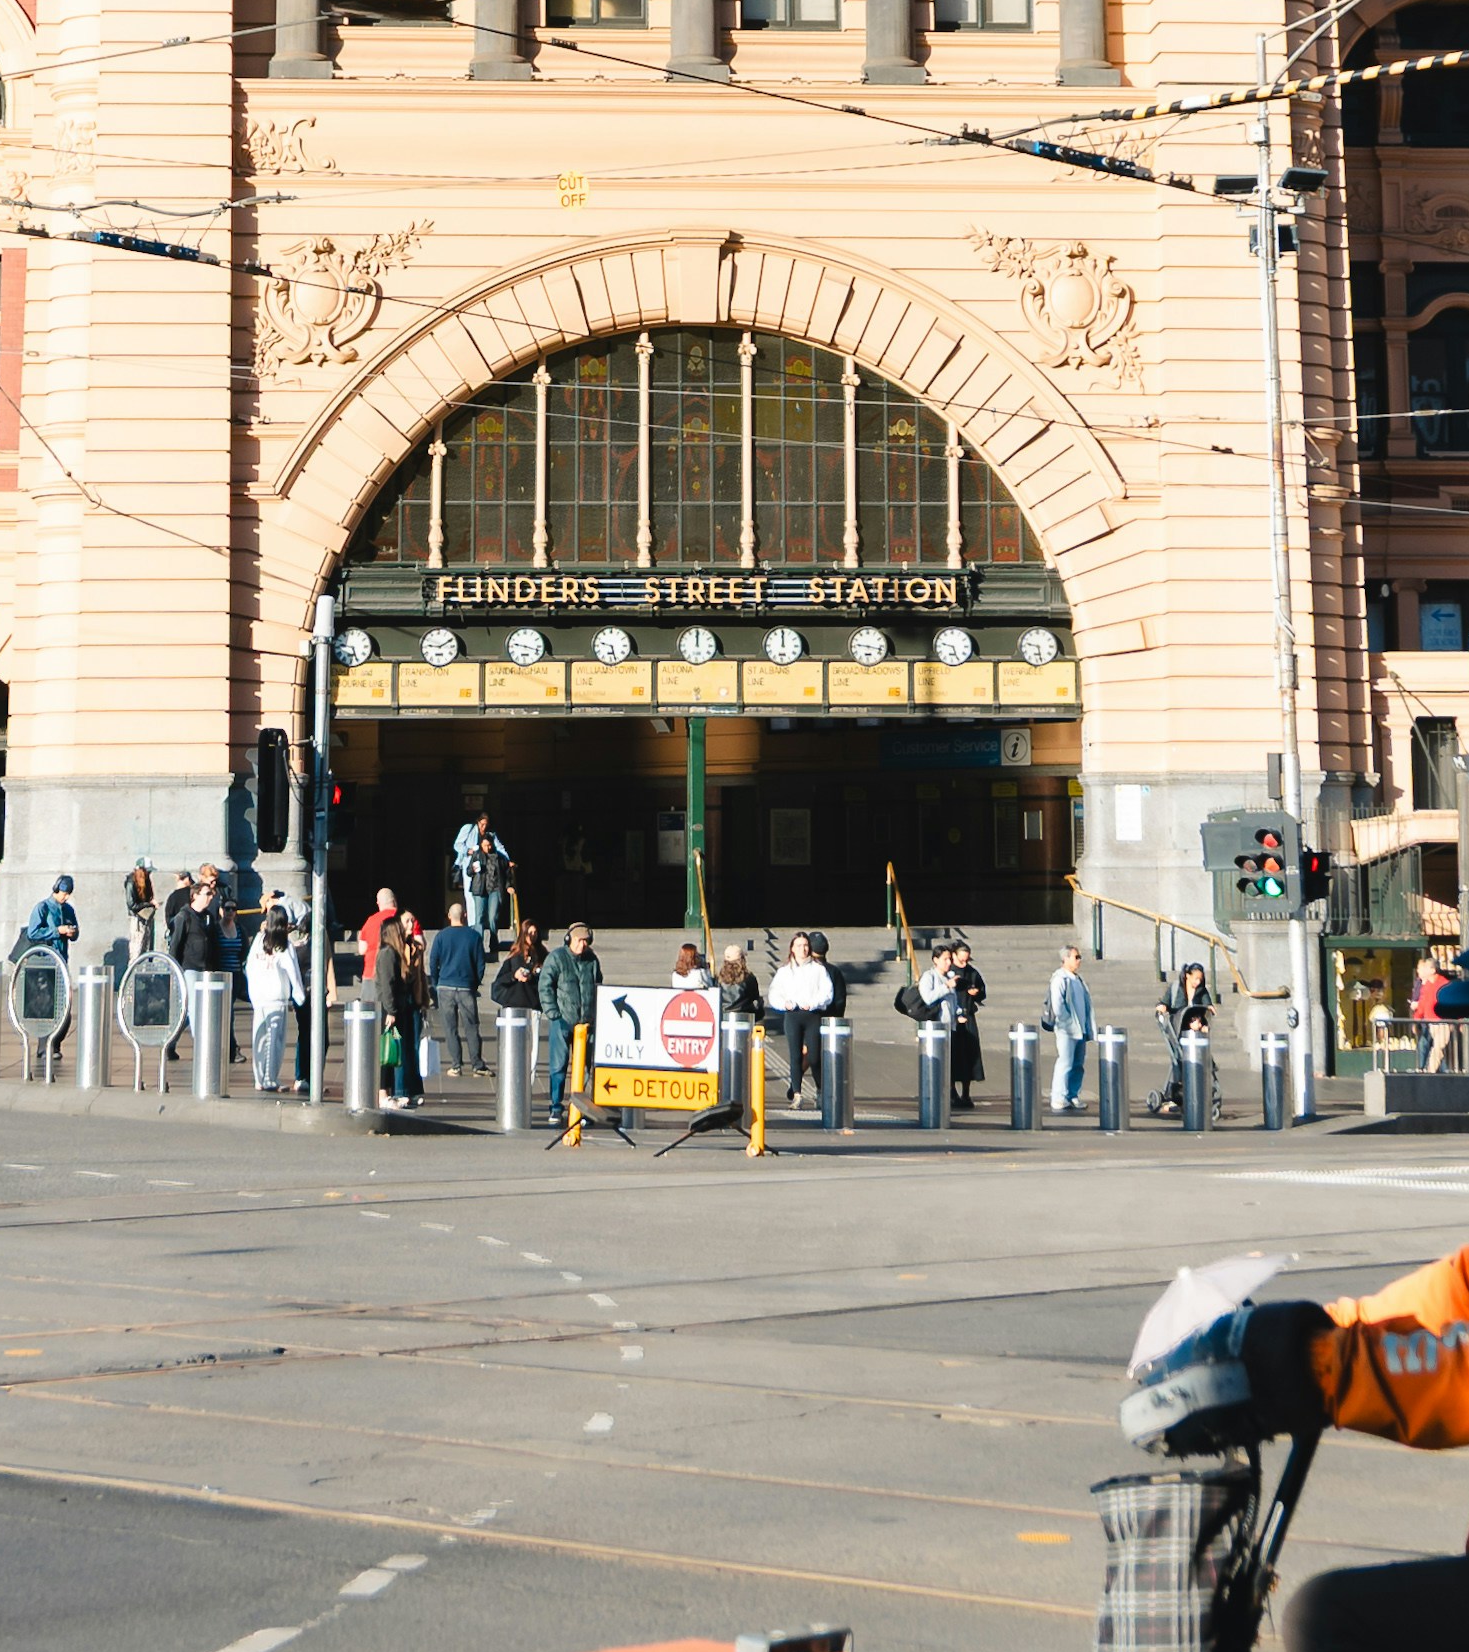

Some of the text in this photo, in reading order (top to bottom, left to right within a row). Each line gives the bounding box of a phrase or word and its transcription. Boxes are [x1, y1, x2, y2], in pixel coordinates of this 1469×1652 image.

[558, 176, 585, 191] CUT
[560, 193, 587, 207] OFF
[436, 576, 957, 604] FLINDERS STREET STATION
[576, 666, 638, 675] WILLIAMSTOWN
[662, 665, 694, 674] ALTONA
[400, 679, 418, 688] LINE
[488, 678, 506, 687] LINE
[575, 678, 594, 686] LINE
[662, 677, 680, 685] LINE
[747, 678, 765, 686] LINE
[832, 678, 850, 687] LINE
[918, 678, 936, 686] LINE
[891, 739, 952, 756] Customer
[953, 739, 999, 753] Service
[680, 1002, 698, 1019] NO
[667, 1037, 709, 1056] ENTRY
[604, 1043, 645, 1060] ONLY
[633, 1078, 711, 1101] DETOUR
